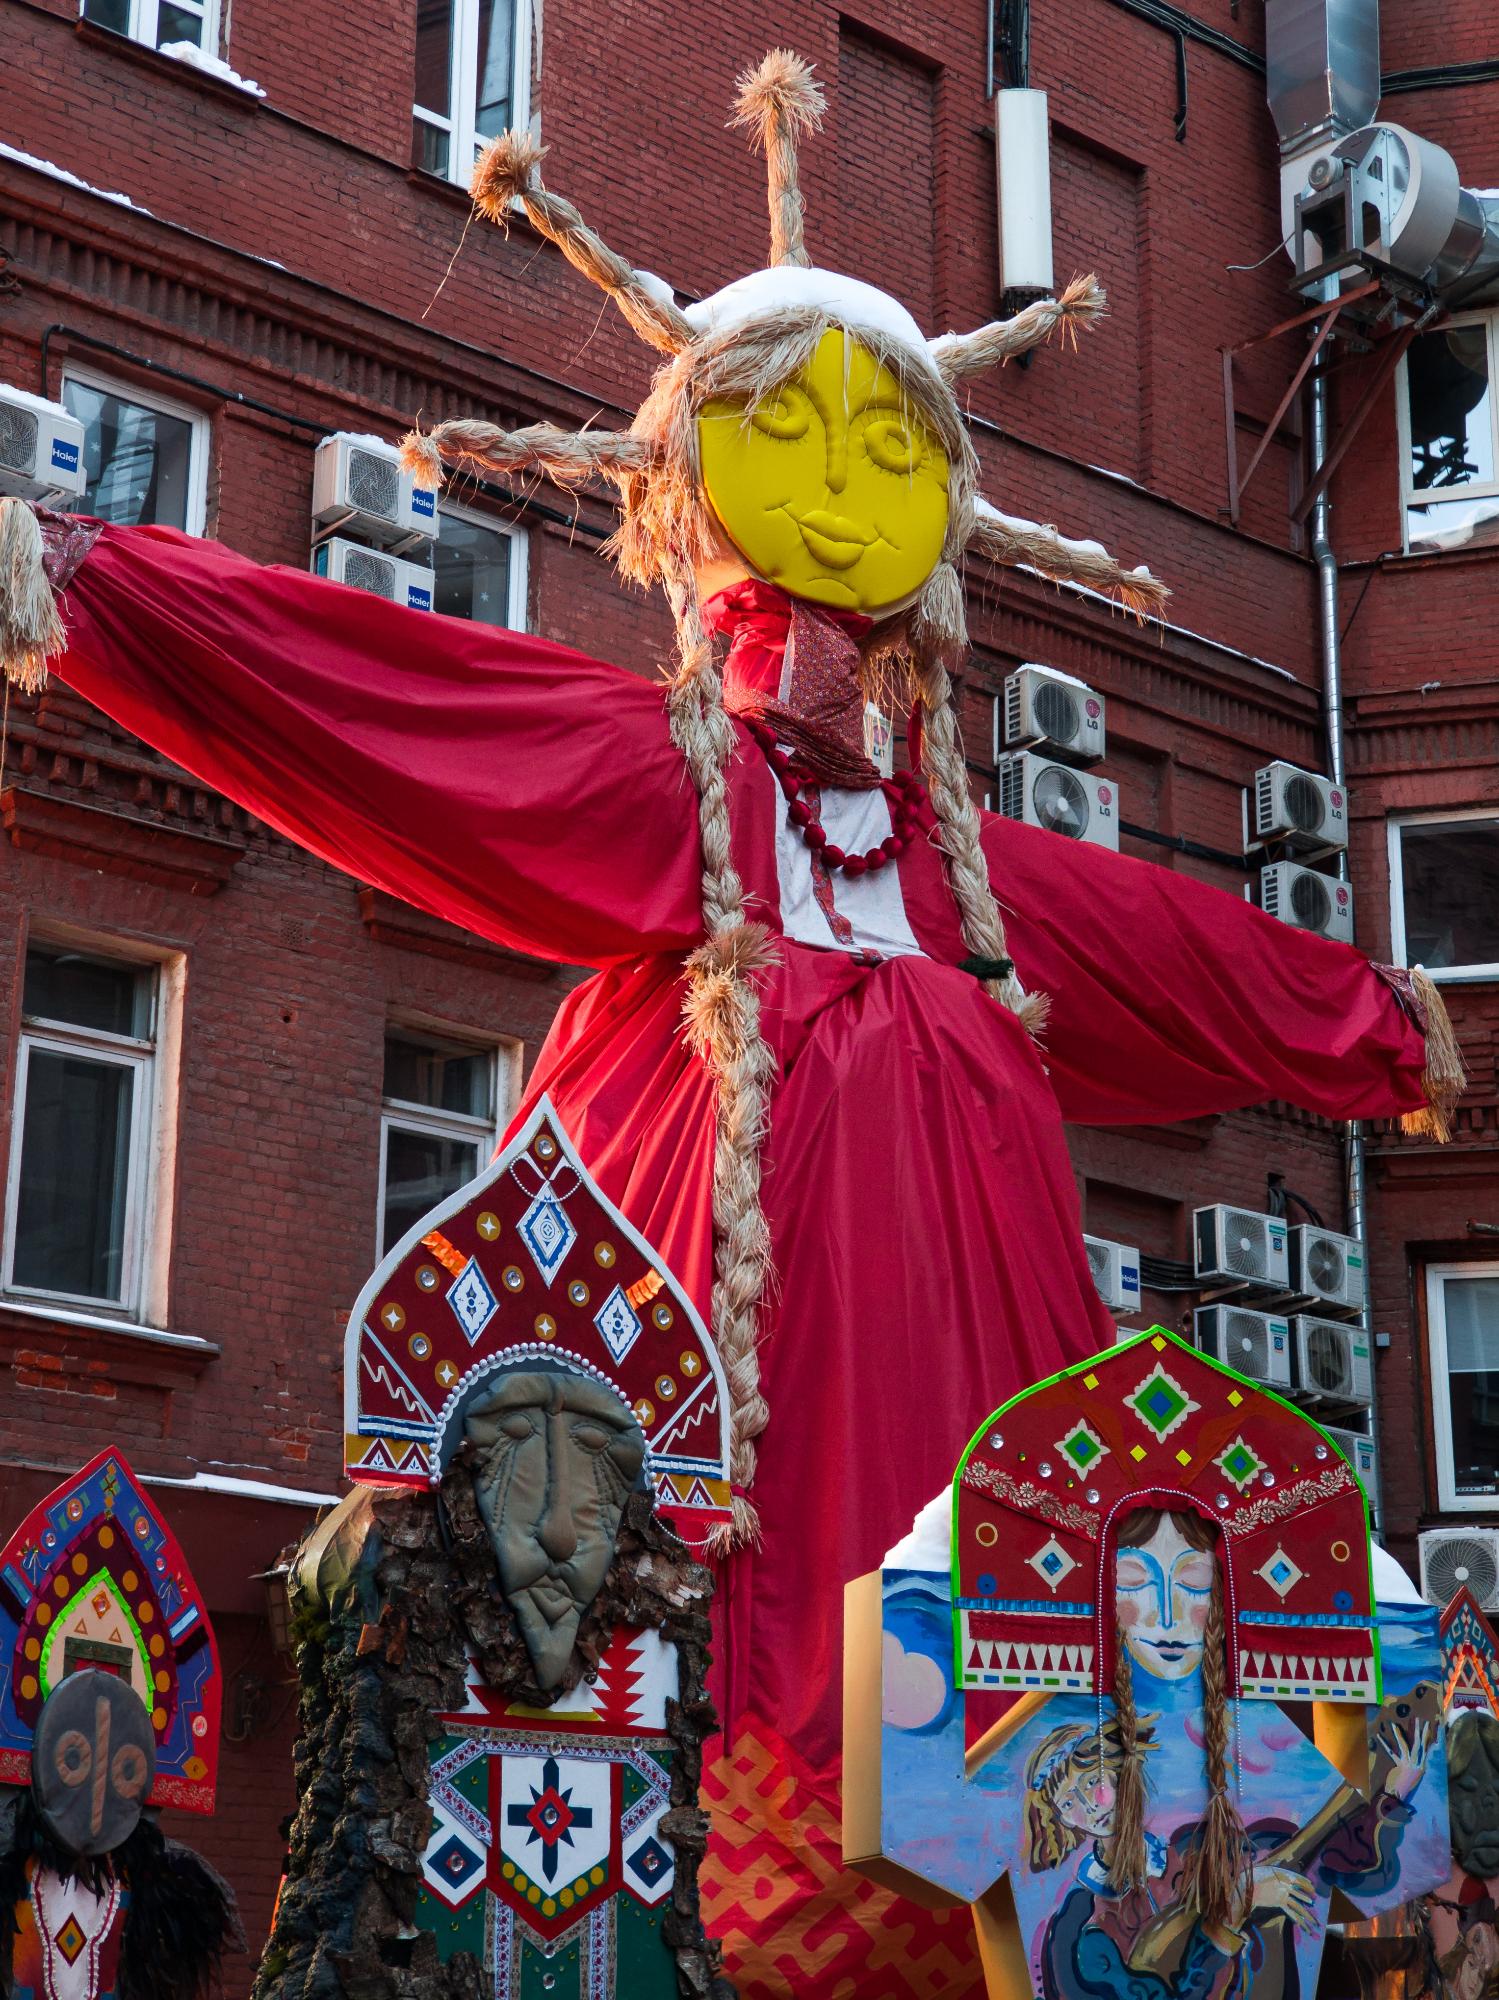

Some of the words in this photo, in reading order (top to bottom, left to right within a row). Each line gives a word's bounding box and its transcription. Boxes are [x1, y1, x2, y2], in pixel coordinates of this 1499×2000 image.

[52, 447, 78, 463] Haier
[412, 495, 434, 510] Haier
[408, 594, 430, 608] Haier
[1087, 718, 1098, 730] LG
[1099, 805, 1111, 817] LG
[1331, 808, 1342, 820] LG
[1337, 906, 1347, 917] LG
